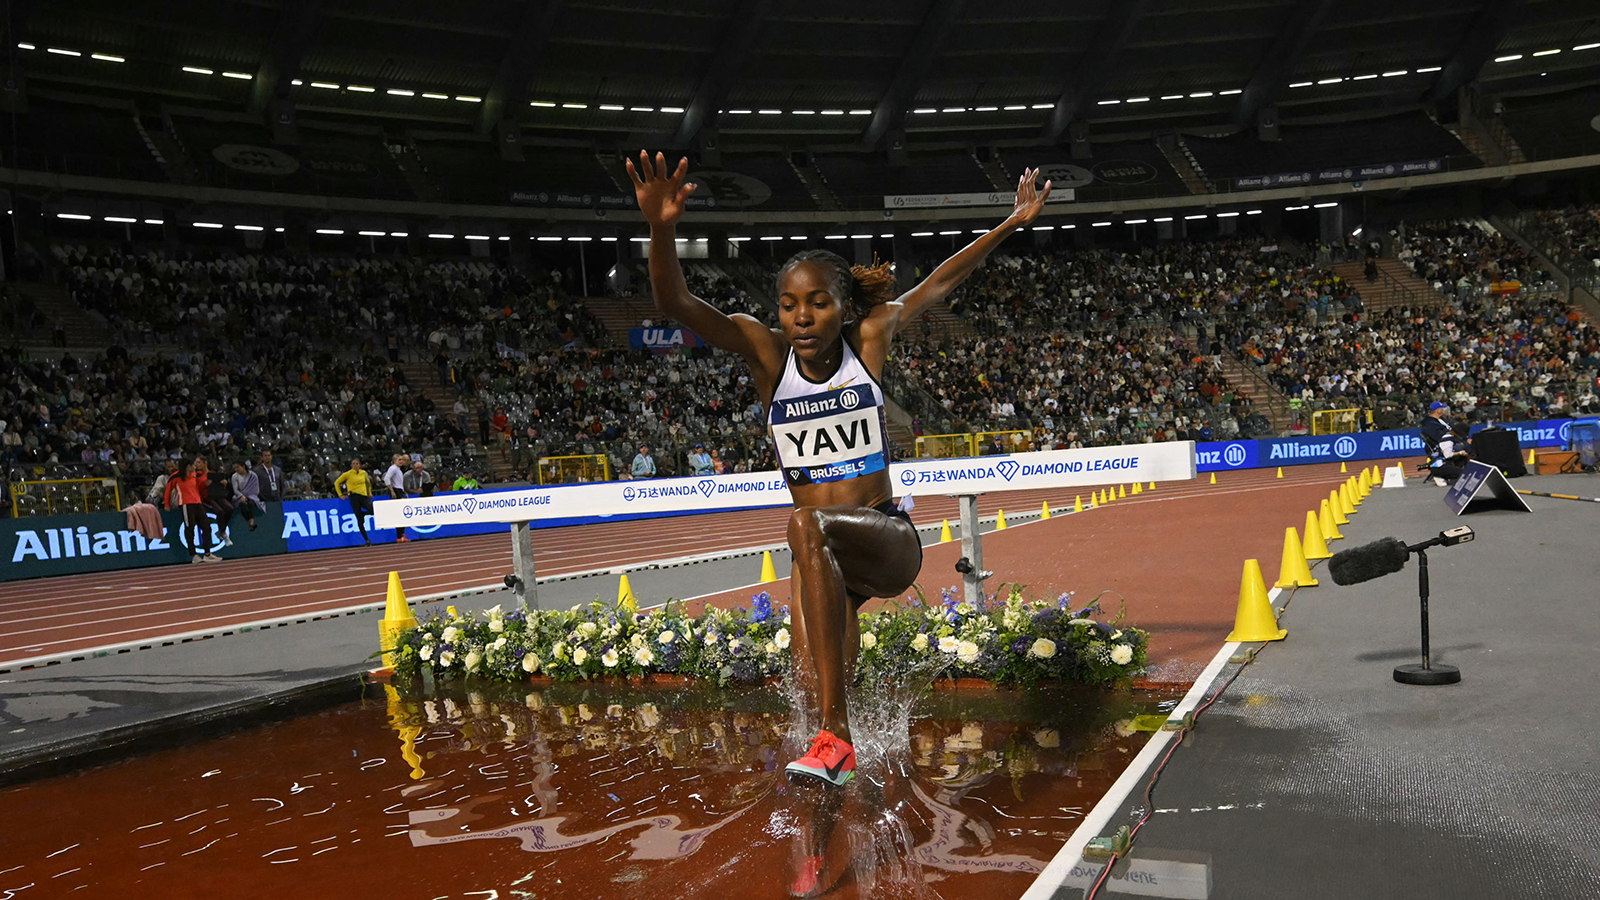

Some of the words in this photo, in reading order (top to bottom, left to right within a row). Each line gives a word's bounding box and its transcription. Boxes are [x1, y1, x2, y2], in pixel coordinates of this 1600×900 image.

[1360, 166, 1385, 176] Allianz
[1402, 163, 1427, 172] Allianz
[1278, 174, 1302, 183] Allianz
[1319, 170, 1343, 180] Allianz
[1238, 177, 1262, 187] Allianz
[513, 191, 538, 201] Allianz
[557, 194, 581, 203] Allianz
[600, 195, 624, 204] Allianz
[642, 329, 684, 345] ULA
[785, 398, 838, 418] Allianz
[785, 418, 871, 458] YAVI
[1380, 434, 1425, 452] Allia
[1270, 442, 1331, 460] Allianz
[809, 460, 866, 480] BRUSSELS
[1021, 461, 1083, 478] DIAMOND
[1086, 457, 1139, 472] LEAGUE
[13, 483, 26, 494] 30
[717, 481, 765, 494] DIAMOND
[767, 480, 789, 491] LEA
[478, 498, 517, 510] DIAMOND
[518, 495, 551, 507] LEAGUE
